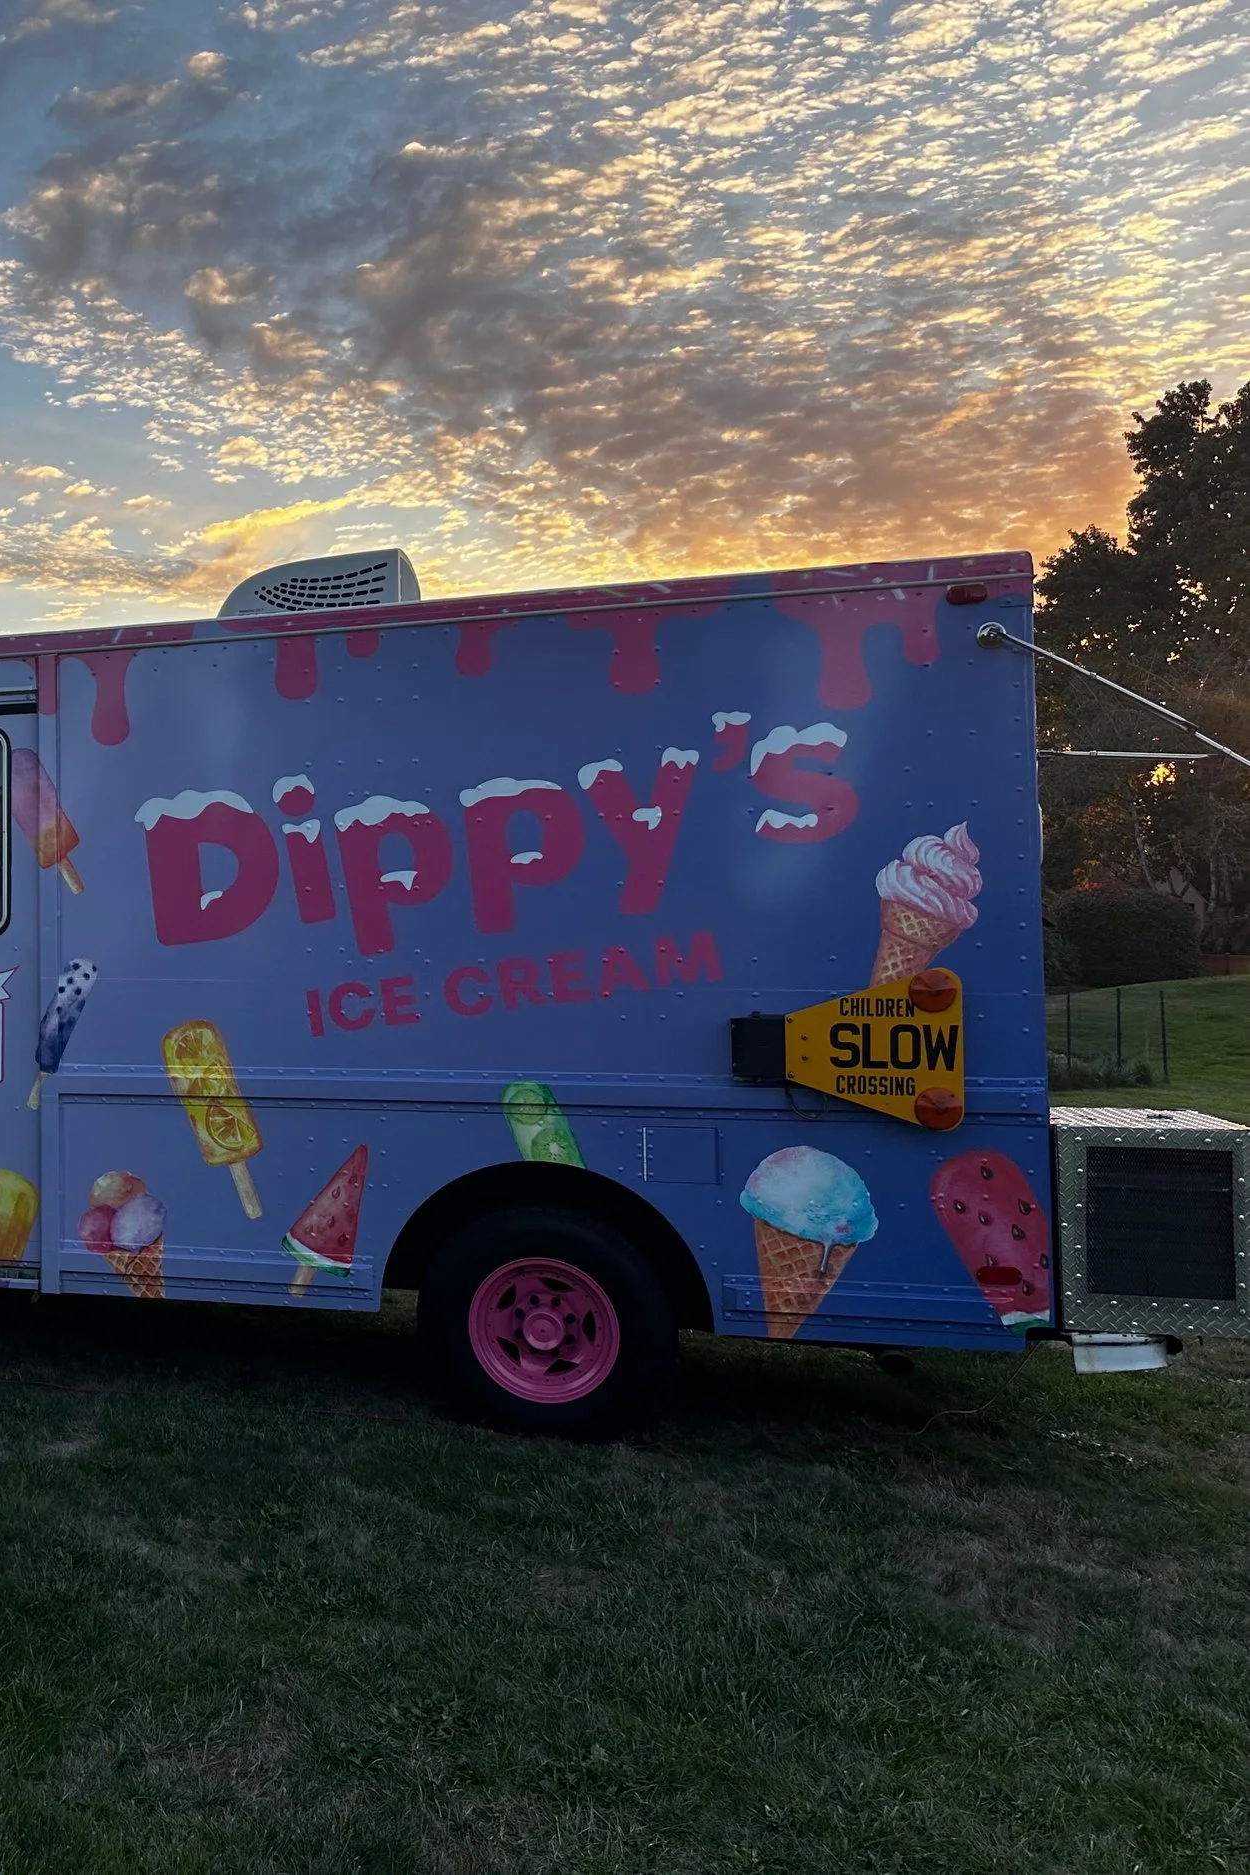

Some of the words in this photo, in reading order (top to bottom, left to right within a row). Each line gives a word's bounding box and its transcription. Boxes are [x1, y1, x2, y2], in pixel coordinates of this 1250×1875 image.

[306, 977, 421, 1037] ICE
[443, 931, 723, 1017] CREAM
[839, 997, 915, 1018] CHILDREN
[829, 1022, 959, 1072] SLOW
[836, 1074, 916, 1097] CROSSING
